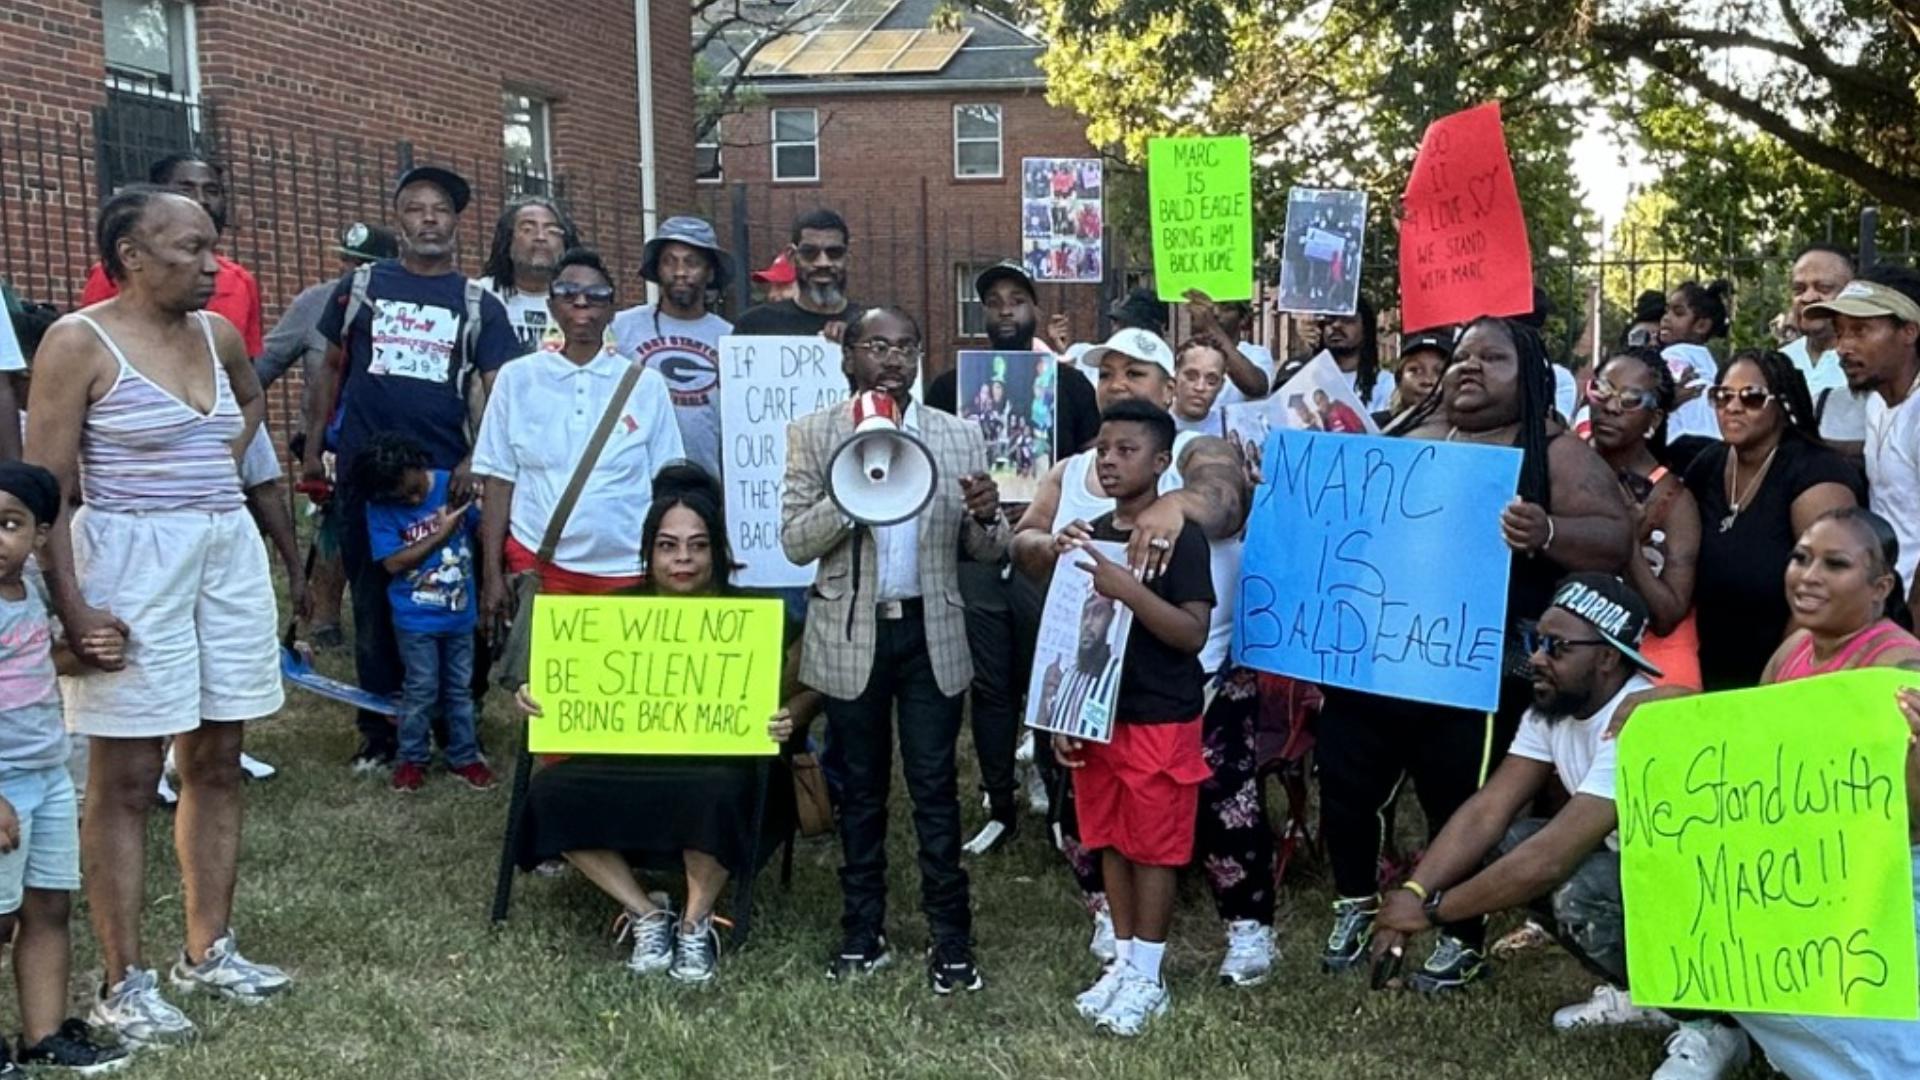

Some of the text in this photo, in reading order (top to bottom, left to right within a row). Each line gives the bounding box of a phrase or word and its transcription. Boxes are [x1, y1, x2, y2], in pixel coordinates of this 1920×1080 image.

[1174, 142, 1220, 168] MARC
[1186, 171, 1206, 195] IS
[1159, 192, 1246, 223] BALD EAGLE
[1428, 195, 1464, 232] LOVE
[1162, 223, 1234, 250] BRING HIM
[1417, 230, 1486, 265] WE STAND
[1170, 248, 1236, 274] BACK HOME
[1419, 258, 1485, 292] WITH MARC
[780, 346, 827, 379] DPR
[745, 385, 800, 424] CARE
[735, 433, 777, 469] OUR
[738, 480, 782, 510] THEY
[1260, 434, 1444, 525] MARC
[550, 607, 754, 643] WE WILL NOT
[1241, 575, 1502, 671] BALD EAGLE
[1553, 582, 1631, 637] FLORIDA
[546, 650, 753, 700] BE SILENT!
[558, 699, 750, 736] BRING BACK MARC
[1622, 757, 1682, 847] We
[1679, 741, 1787, 852] Stand
[1671, 928, 1888, 1006] Williams
